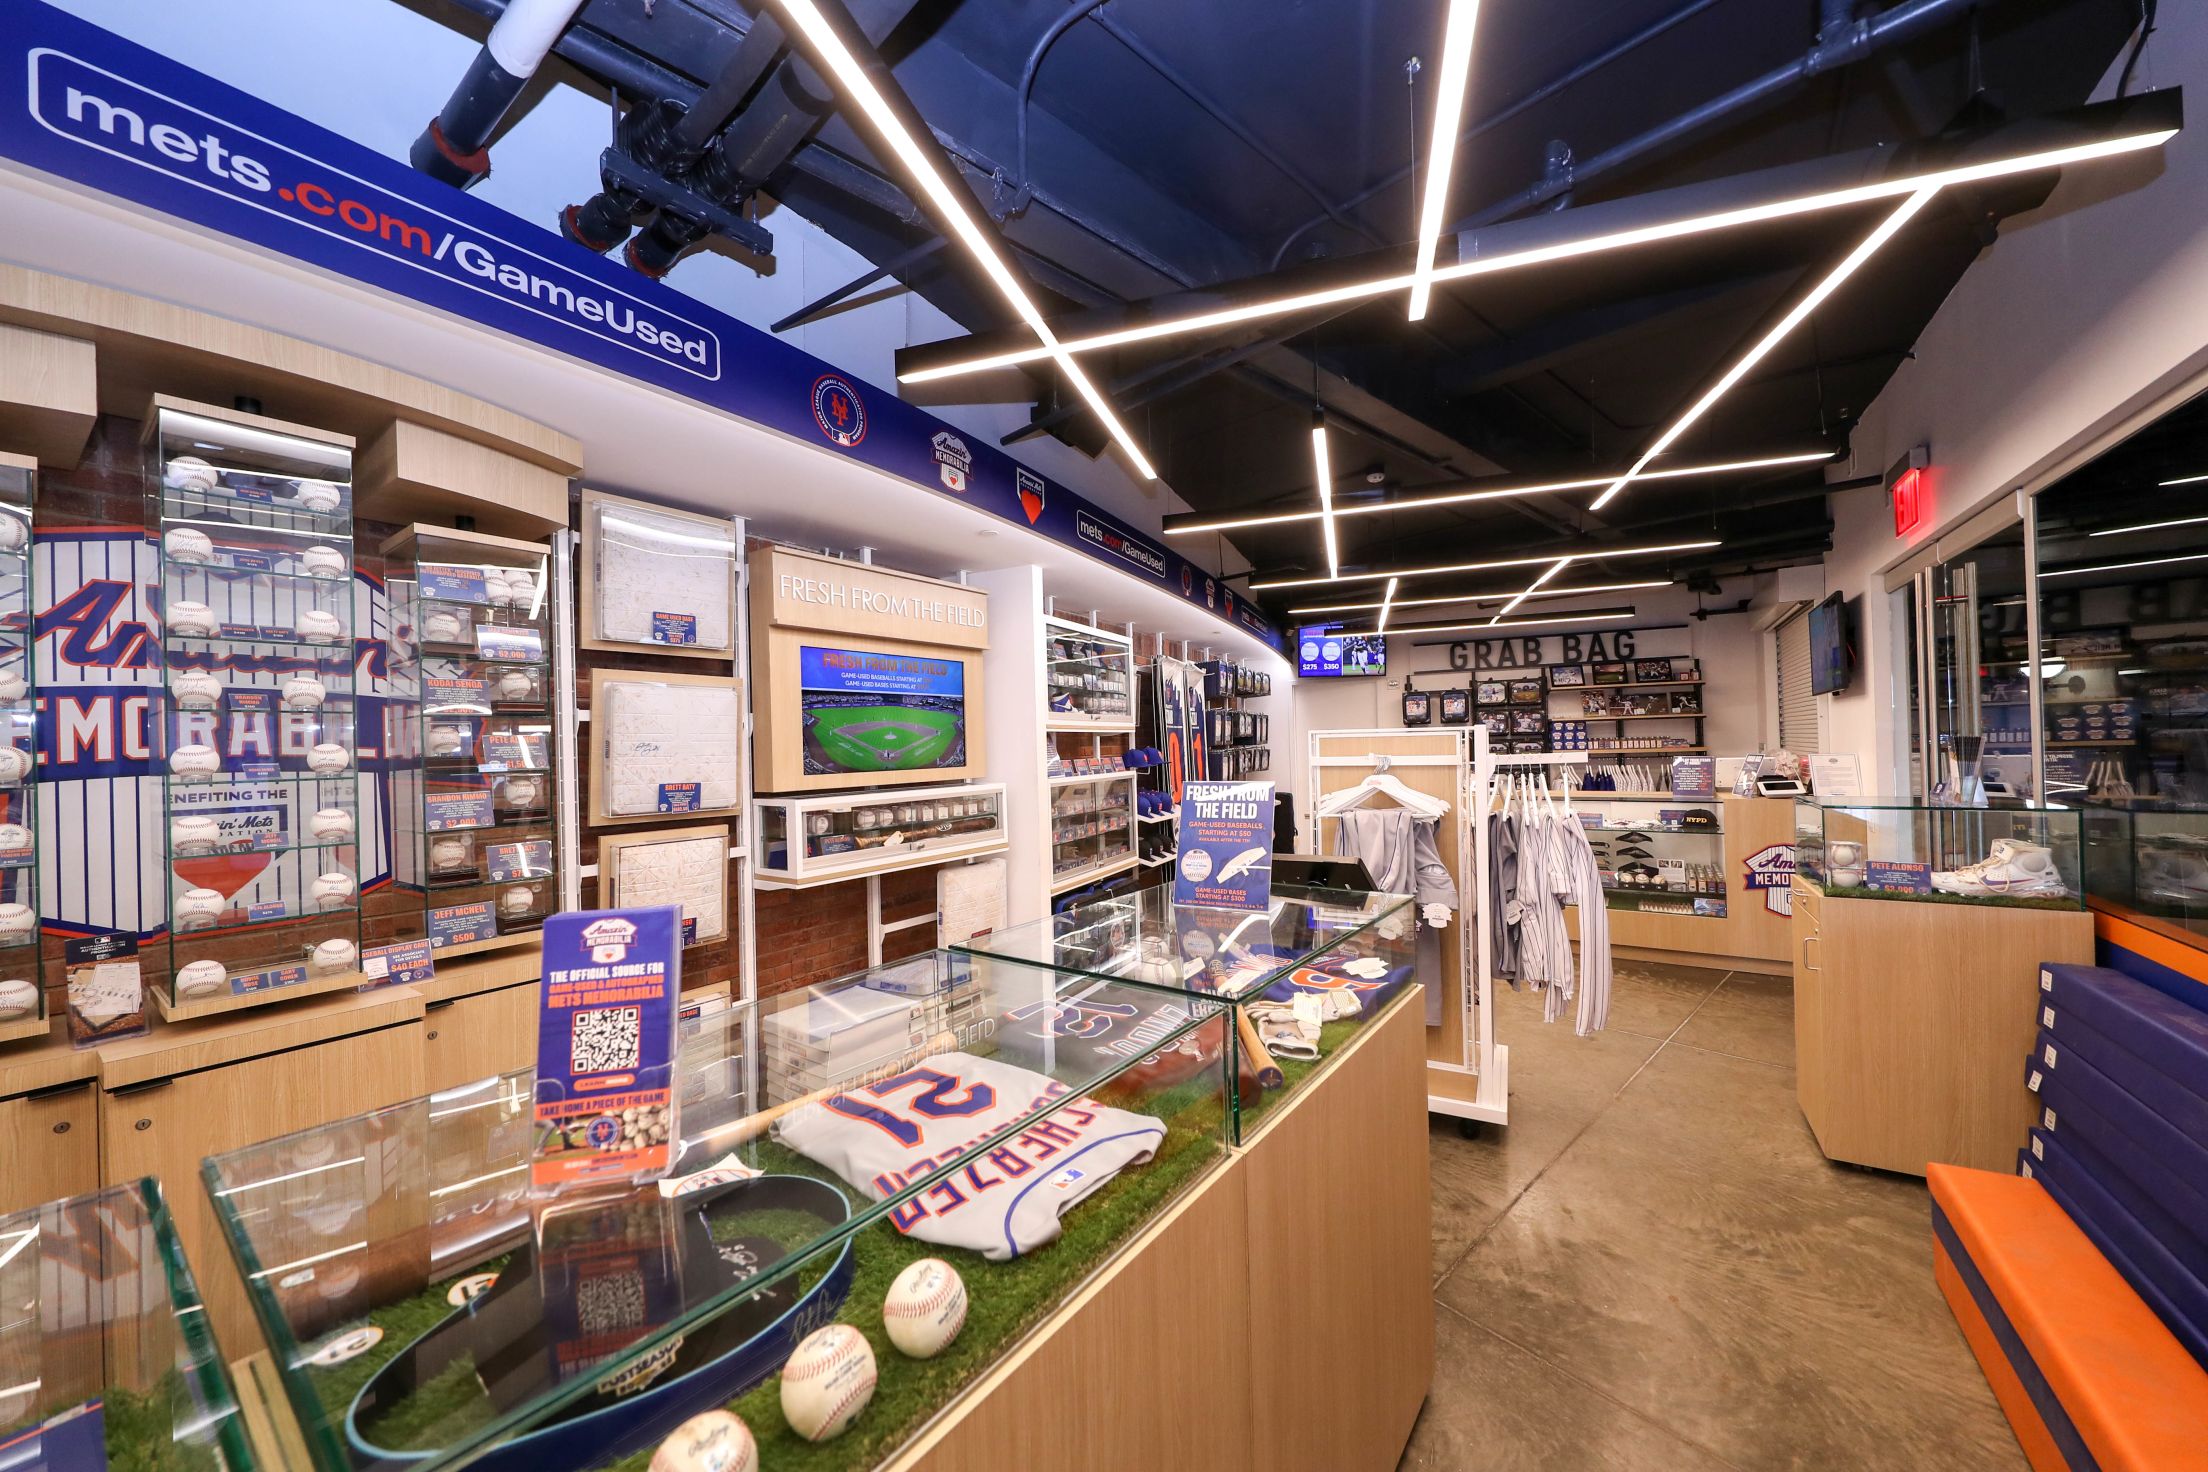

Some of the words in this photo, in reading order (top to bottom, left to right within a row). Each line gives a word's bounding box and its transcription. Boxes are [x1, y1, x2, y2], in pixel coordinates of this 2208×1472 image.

[66, 86, 708, 366] mets.com/GameUsed
[935, 450, 970, 475] MEMORABILIA
[1081, 519, 1164, 571] mets.com/GameUsed
[780, 574, 846, 608] FRESH
[851, 587, 908, 617] FROM
[912, 598, 942, 622] THE
[946, 604, 986, 628] FIELD
[1450, 637, 1543, 671] GRAB
[1563, 631, 1636, 663] BAG
[823, 653, 862, 669] FRESH
[865, 657, 898, 672] FROM
[901, 660, 919, 674] THE
[921, 662, 948, 676] FIELD
[427, 679, 454, 688] KODAI
[841, 672, 870, 680] GAME-USED
[489, 736, 508, 744] PETE
[167, 789, 253, 805] ENEFITING
[257, 788, 288, 800] THE
[427, 794, 461, 803] BRANDON
[462, 793, 487, 801] NIMMO
[1195, 802, 1220, 819] THE
[1221, 802, 1258, 819] FIELD
[238, 816, 274, 829] Mets
[1686, 816, 1708, 824] NYPD
[1199, 829, 1228, 837] STARTING
[499, 846, 517, 855] BRET
[1871, 862, 1890, 871] PETE
[1891, 862, 1925, 872] ALONSO
[434, 907, 455, 920] JEFF
[455, 905, 487, 917] MCNEIL
[453, 933, 475, 944] $500
[586, 935, 632, 947] MEMORABILIA
[362, 949, 388, 958] ASEBALL
[388, 944, 412, 954] DISPLAY
[414, 941, 428, 949] CASE
[391, 963, 408, 972] $40
[409, 959, 429, 969] EACH
[550, 971, 568, 983] THE
[569, 967, 610, 982] OFFICIAL
[612, 963, 646, 977] SOURCE
[647, 962, 664, 974] FOR
[548, 992, 582, 1009] METS
[583, 985, 664, 1006] MEMORABILIA
[540, 1106, 560, 1116] TAKE
[562, 1102, 585, 1113] HOME
[586, 1101, 592, 1110] A
[593, 1098, 615, 1109] PIECE
[616, 1097, 625, 1106] OF
[628, 1095, 642, 1105] THE
[643, 1092, 665, 1103] GAME
